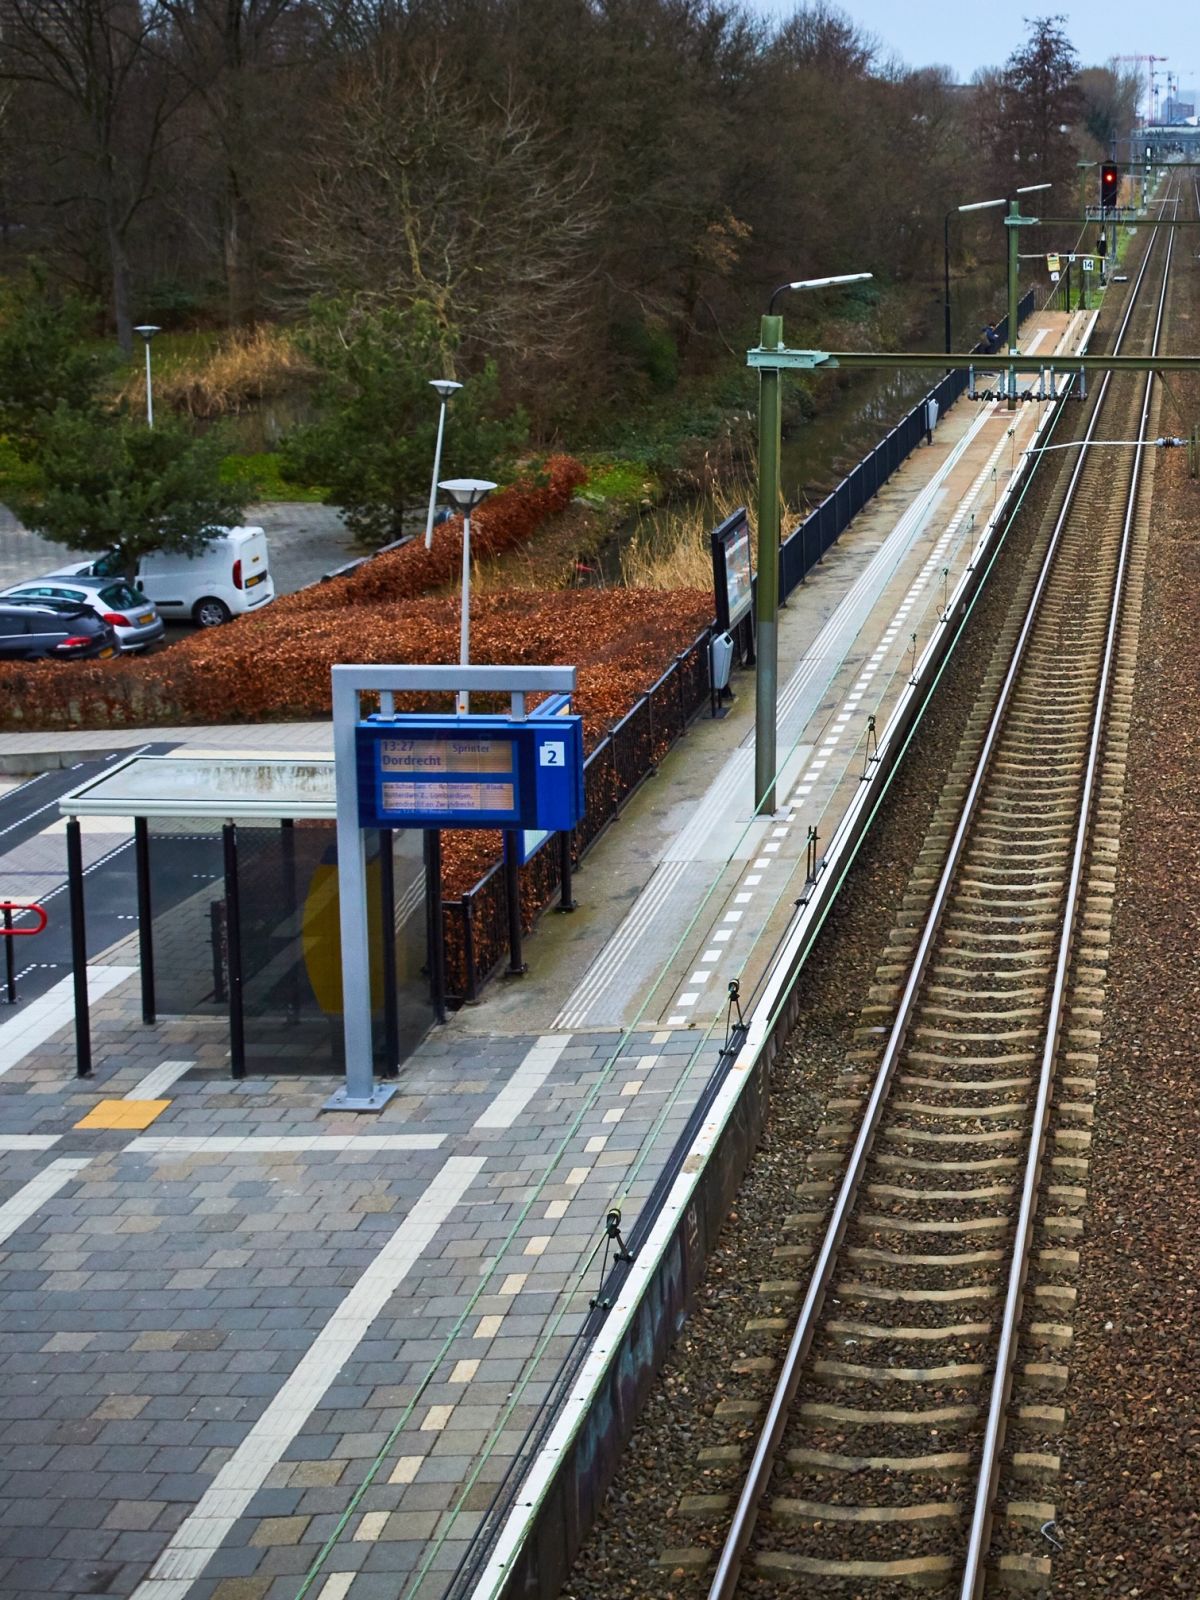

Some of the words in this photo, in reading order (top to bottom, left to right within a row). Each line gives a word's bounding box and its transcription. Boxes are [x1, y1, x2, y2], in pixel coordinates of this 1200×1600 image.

[1084, 261, 1092, 269] 14
[383, 741, 415, 751] 13:27
[453, 744, 489, 755] Sprinter
[383, 755, 441, 766] Dordrecht
[547, 750, 557, 764] 2
